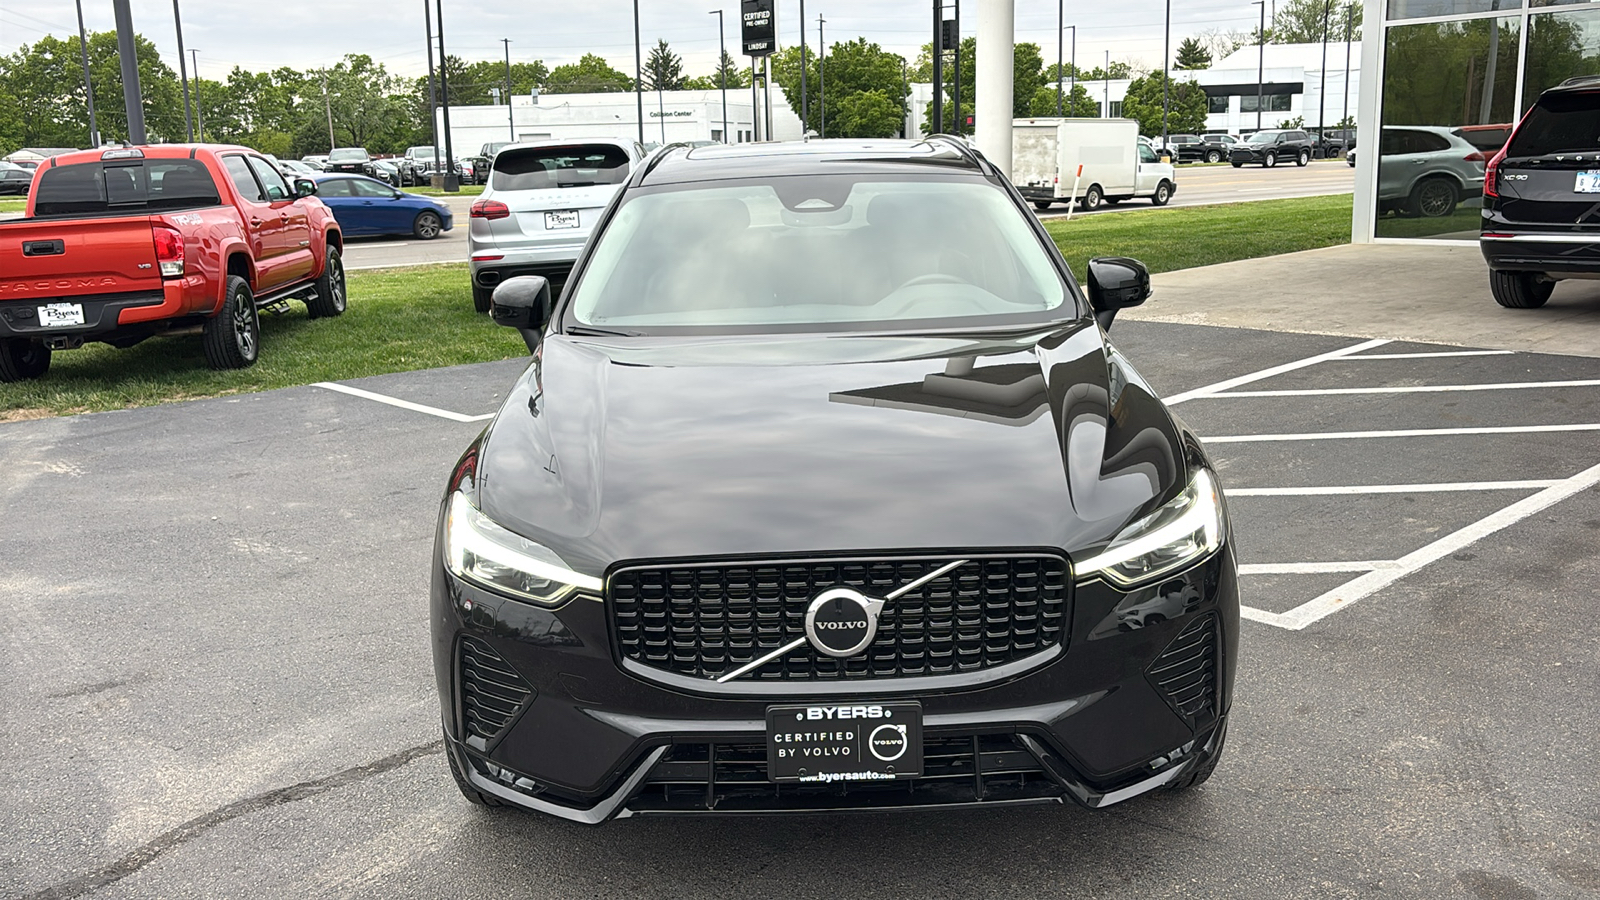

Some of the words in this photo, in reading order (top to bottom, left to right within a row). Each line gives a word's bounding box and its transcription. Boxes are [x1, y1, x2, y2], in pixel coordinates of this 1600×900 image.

[743, 10, 770, 21] CERTIFIED
[746, 19, 768, 27] PRE-OWNED
[748, 42, 768, 50] LINDSAY
[815, 620, 867, 630] VOLVO
[806, 705, 883, 720] BYERS
[774, 731, 854, 743] CERTIFIED
[778, 748, 796, 758] BY
[803, 746, 851, 757] VOLVO
[799, 770, 896, 783] www.byersauto.com
